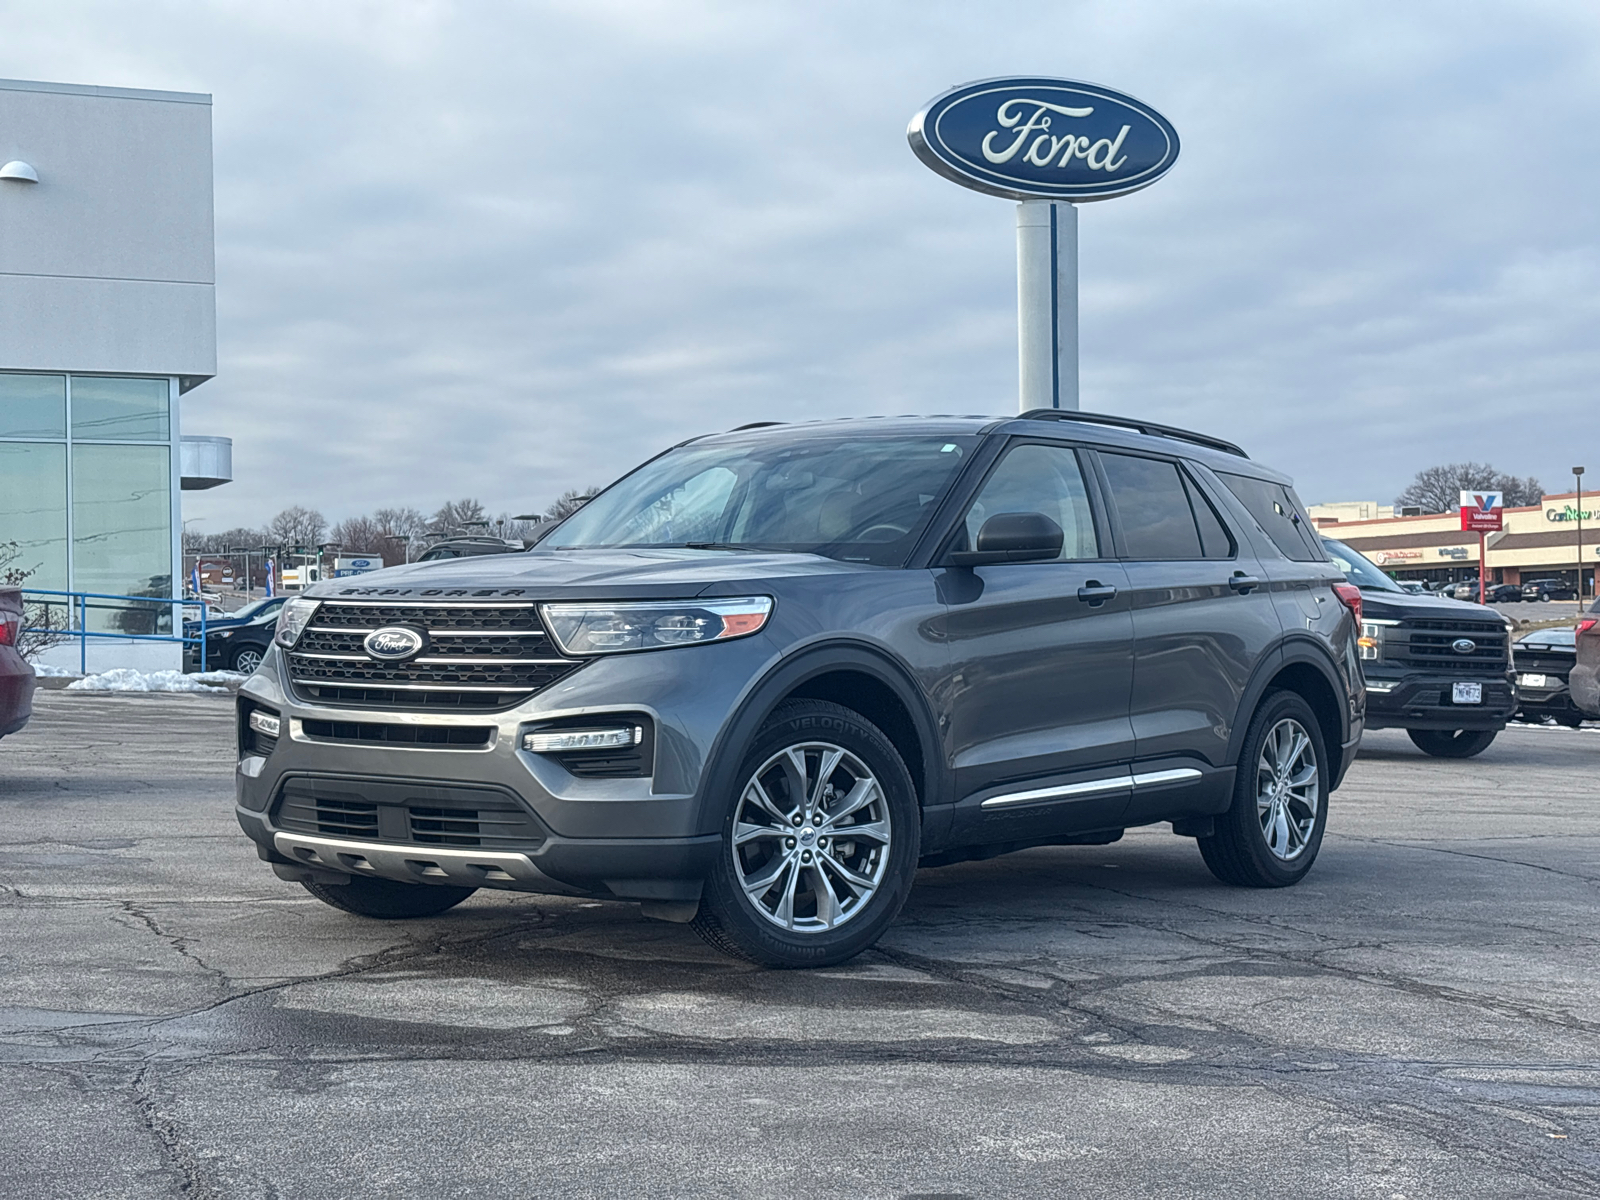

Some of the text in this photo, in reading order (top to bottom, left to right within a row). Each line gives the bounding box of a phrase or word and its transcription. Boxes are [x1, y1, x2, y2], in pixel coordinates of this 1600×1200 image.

[981, 98, 1132, 173] Ford
[374, 632, 410, 652] Ford
[789, 717, 868, 741] VELOCITY
